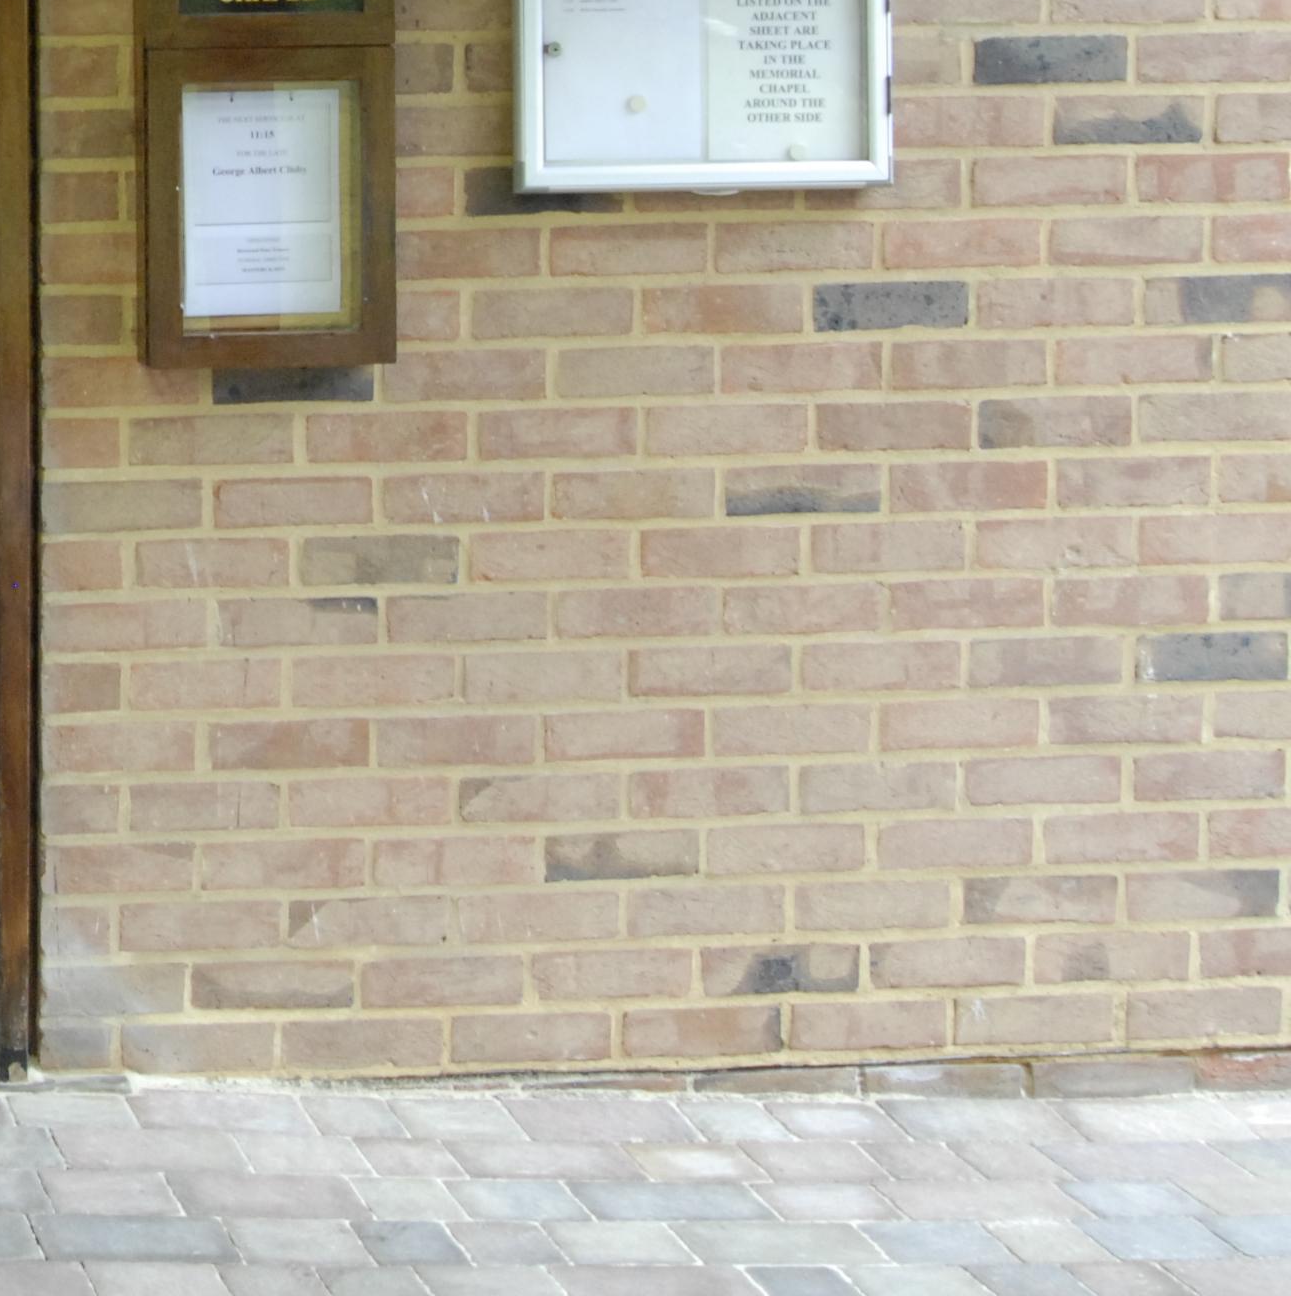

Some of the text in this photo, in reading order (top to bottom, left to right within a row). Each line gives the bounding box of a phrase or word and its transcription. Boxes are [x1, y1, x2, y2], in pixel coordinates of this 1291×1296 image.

[751, 11, 817, 21] ADJACENT
[749, 25, 819, 36] SHEET ARE
[737, 40, 832, 51] TAKING PLACE
[763, 54, 806, 65] IN THE
[749, 69, 821, 79] MEMORIAL
[759, 83, 810, 94] CHAPEL
[744, 98, 826, 109] AROUND THE
[746, 112, 823, 123] OTHER SIDE
[250, 130, 275, 140] 11:15
[212, 166, 246, 177] George
[248, 166, 277, 175] Albert
